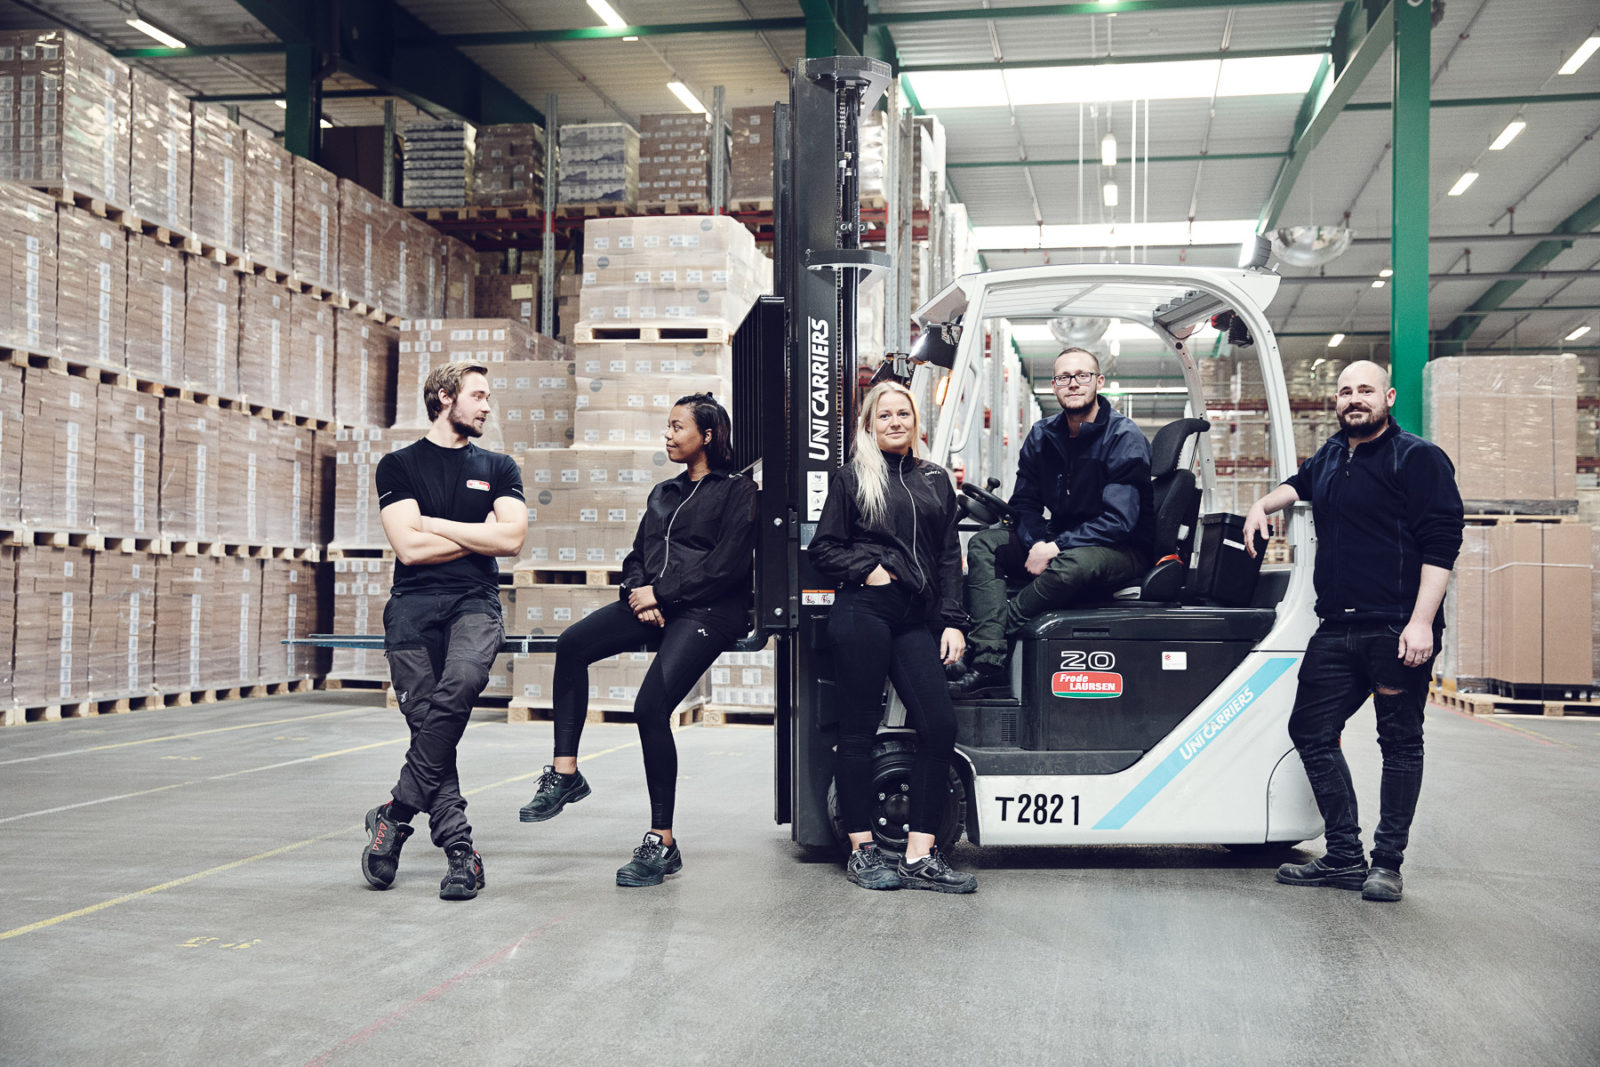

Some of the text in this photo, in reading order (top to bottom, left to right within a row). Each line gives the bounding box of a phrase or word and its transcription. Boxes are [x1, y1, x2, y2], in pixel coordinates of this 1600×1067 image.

[1060, 650, 1116, 670] 20
[1060, 673, 1088, 683] Frode
[1069, 682, 1116, 691] LAURSEN
[995, 793, 1080, 826] T2821
